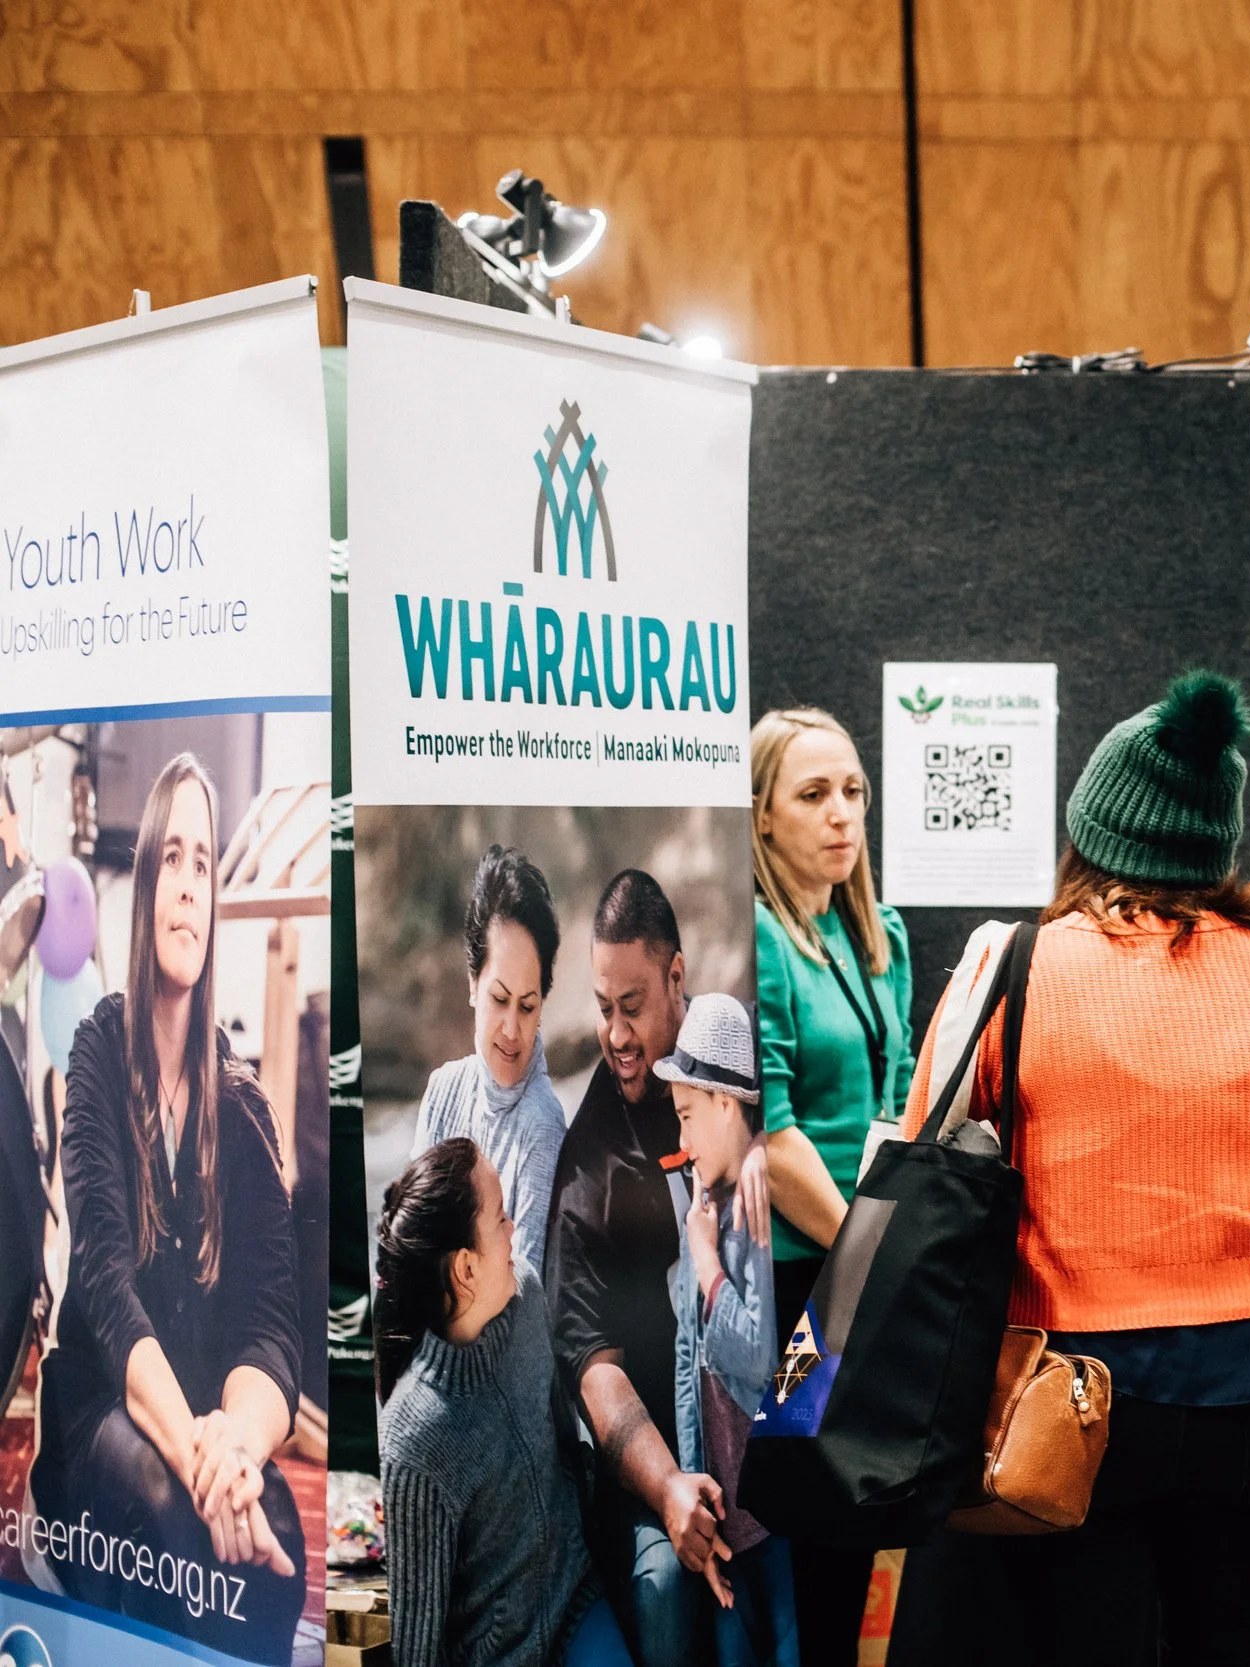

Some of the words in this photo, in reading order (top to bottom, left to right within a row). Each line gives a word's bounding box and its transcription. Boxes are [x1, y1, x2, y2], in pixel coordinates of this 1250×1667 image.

[4, 510, 100, 591] Youth
[114, 493, 205, 578] Work
[1, 606, 95, 662] Upskilling
[102, 601, 134, 644] for
[140, 597, 173, 641] the
[179, 596, 248, 639] Future
[395, 582, 737, 714] WHĀRAURAU
[951, 693, 992, 709] Real
[406, 725, 485, 763] Empower
[489, 730, 513, 758] the
[517, 730, 592, 760] Workforce
[604, 734, 668, 762] Manaaki
[673, 737, 740, 769] Mokopuna
